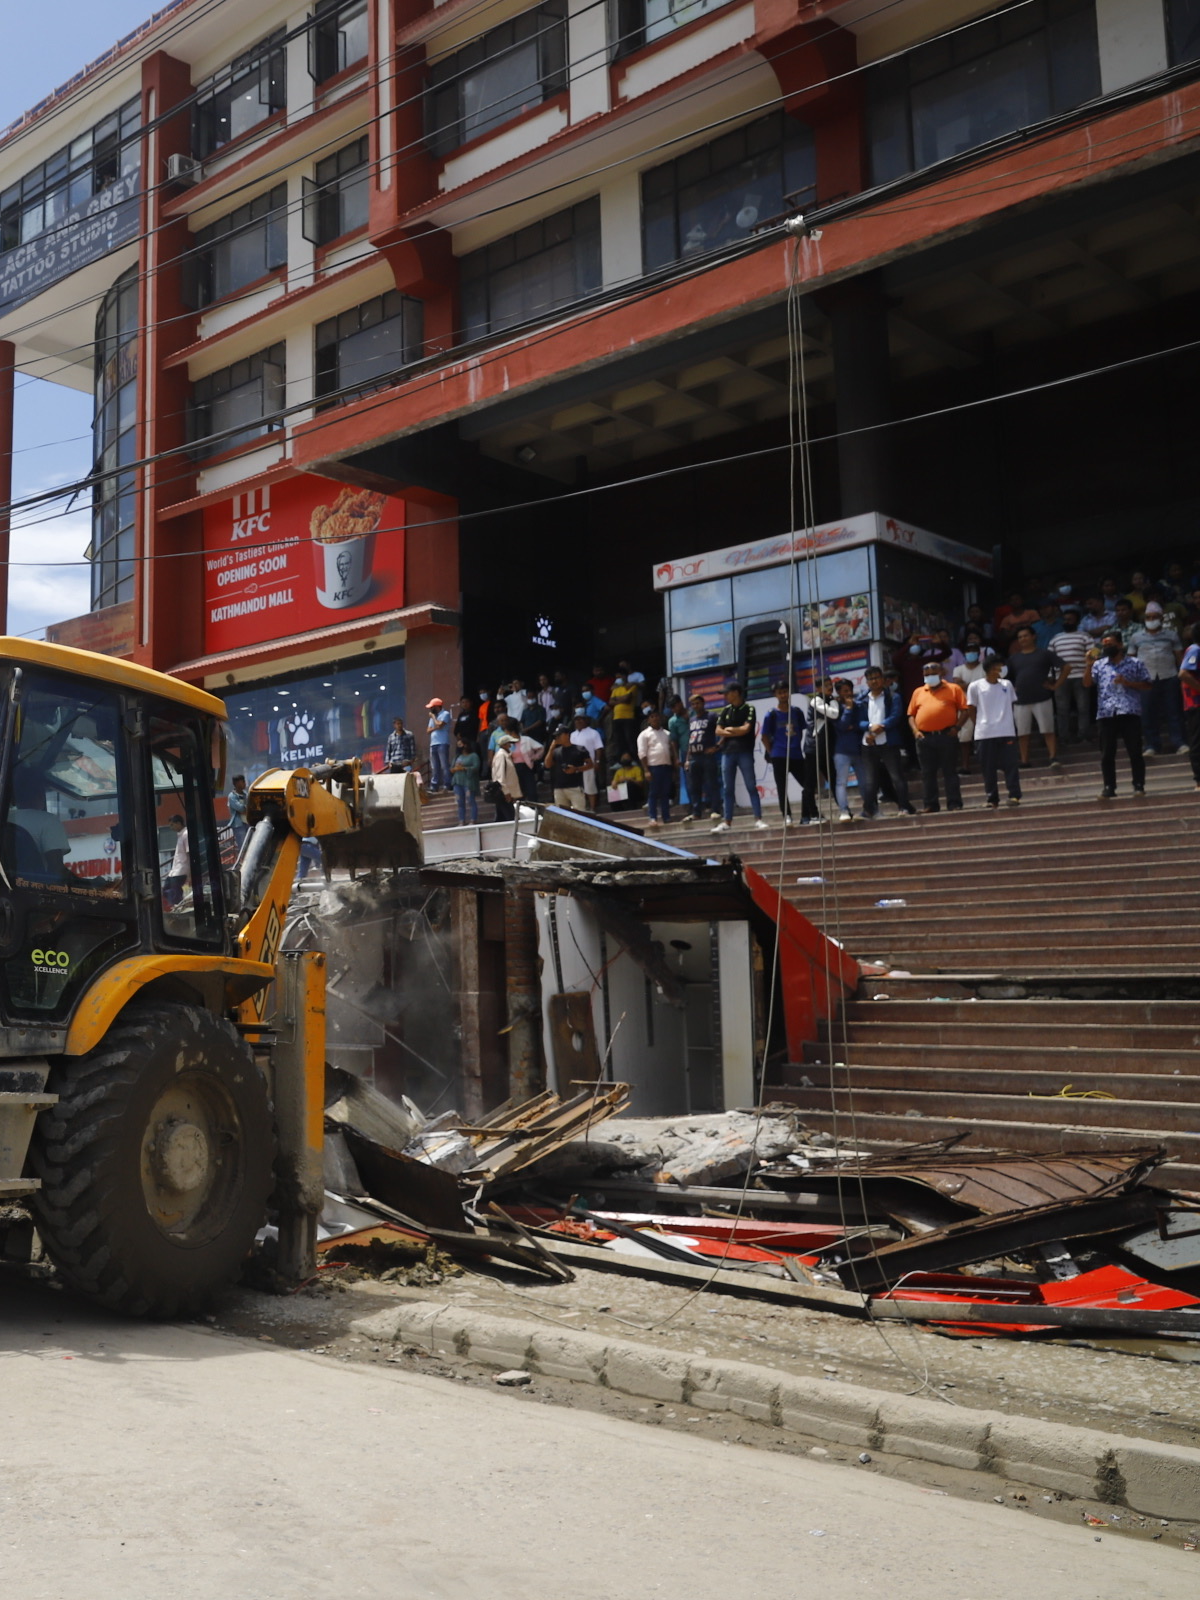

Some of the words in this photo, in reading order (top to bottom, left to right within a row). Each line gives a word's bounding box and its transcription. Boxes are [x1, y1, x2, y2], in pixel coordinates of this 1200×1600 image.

[44, 216, 81, 250] AND
[87, 173, 139, 224] GREY
[1, 250, 55, 298] TATTOO
[60, 211, 118, 260] STUDIO
[230, 512, 271, 541] KFC
[207, 554, 234, 571] World's
[235, 544, 266, 563] Tastiest
[267, 535, 300, 551] Chicken
[217, 563, 257, 587] OPENING
[258, 554, 287, 575] SOON
[211, 596, 267, 623] KATHMANDU
[268, 589, 294, 607] MALL
[333, 589, 355, 601] KFC
[532, 636, 556, 648] KELME
[280, 744, 324, 763] KELME
[31, 948, 70, 967] eco
[33, 965, 69, 975] XCELLENCE
